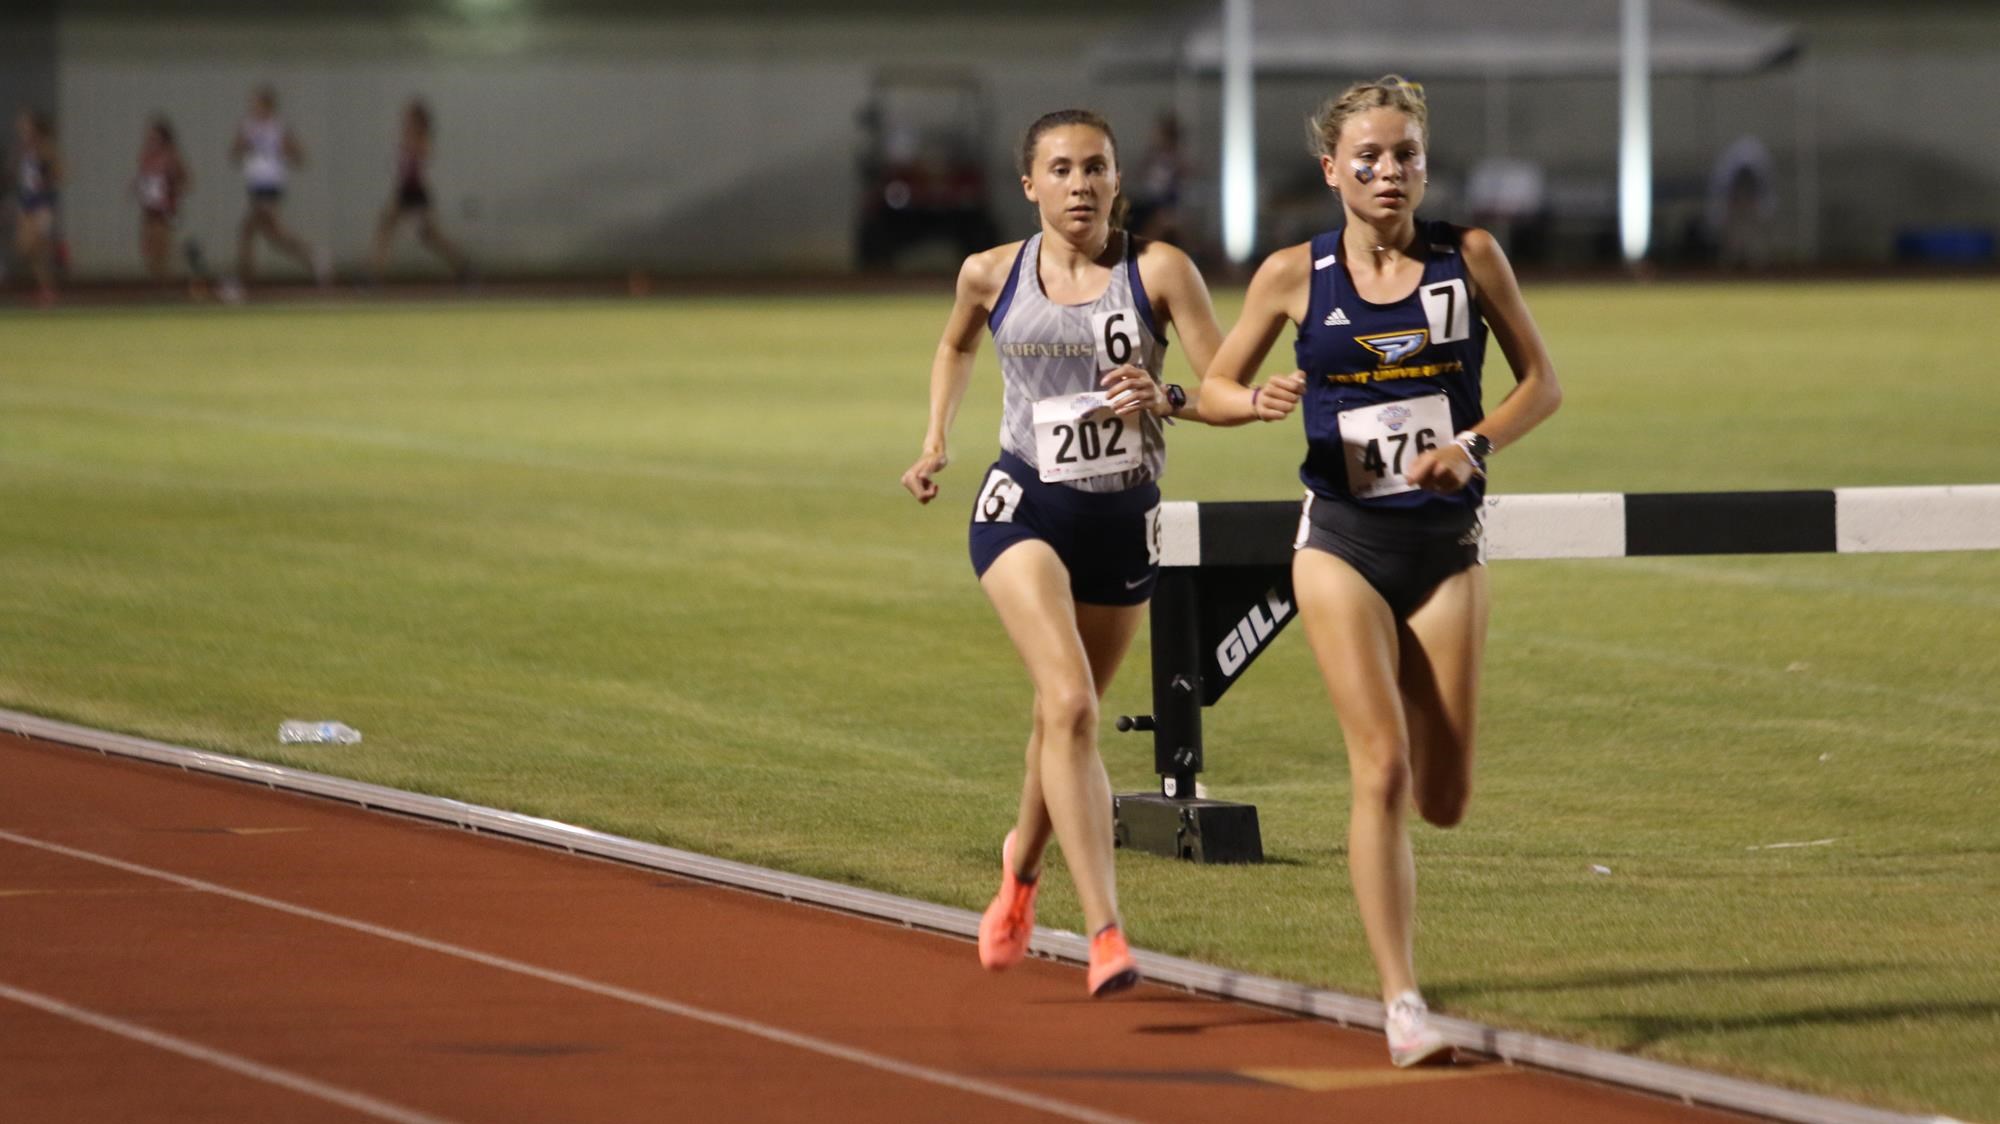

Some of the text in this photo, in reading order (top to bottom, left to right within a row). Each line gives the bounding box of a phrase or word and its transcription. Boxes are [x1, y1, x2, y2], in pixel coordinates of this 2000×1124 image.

[1429, 285, 1455, 339] 7
[1103, 313, 1132, 364] 6
[1052, 416, 1126, 464] 202
[983, 478, 1013, 521] 6
[1215, 588, 1291, 677] GILL
